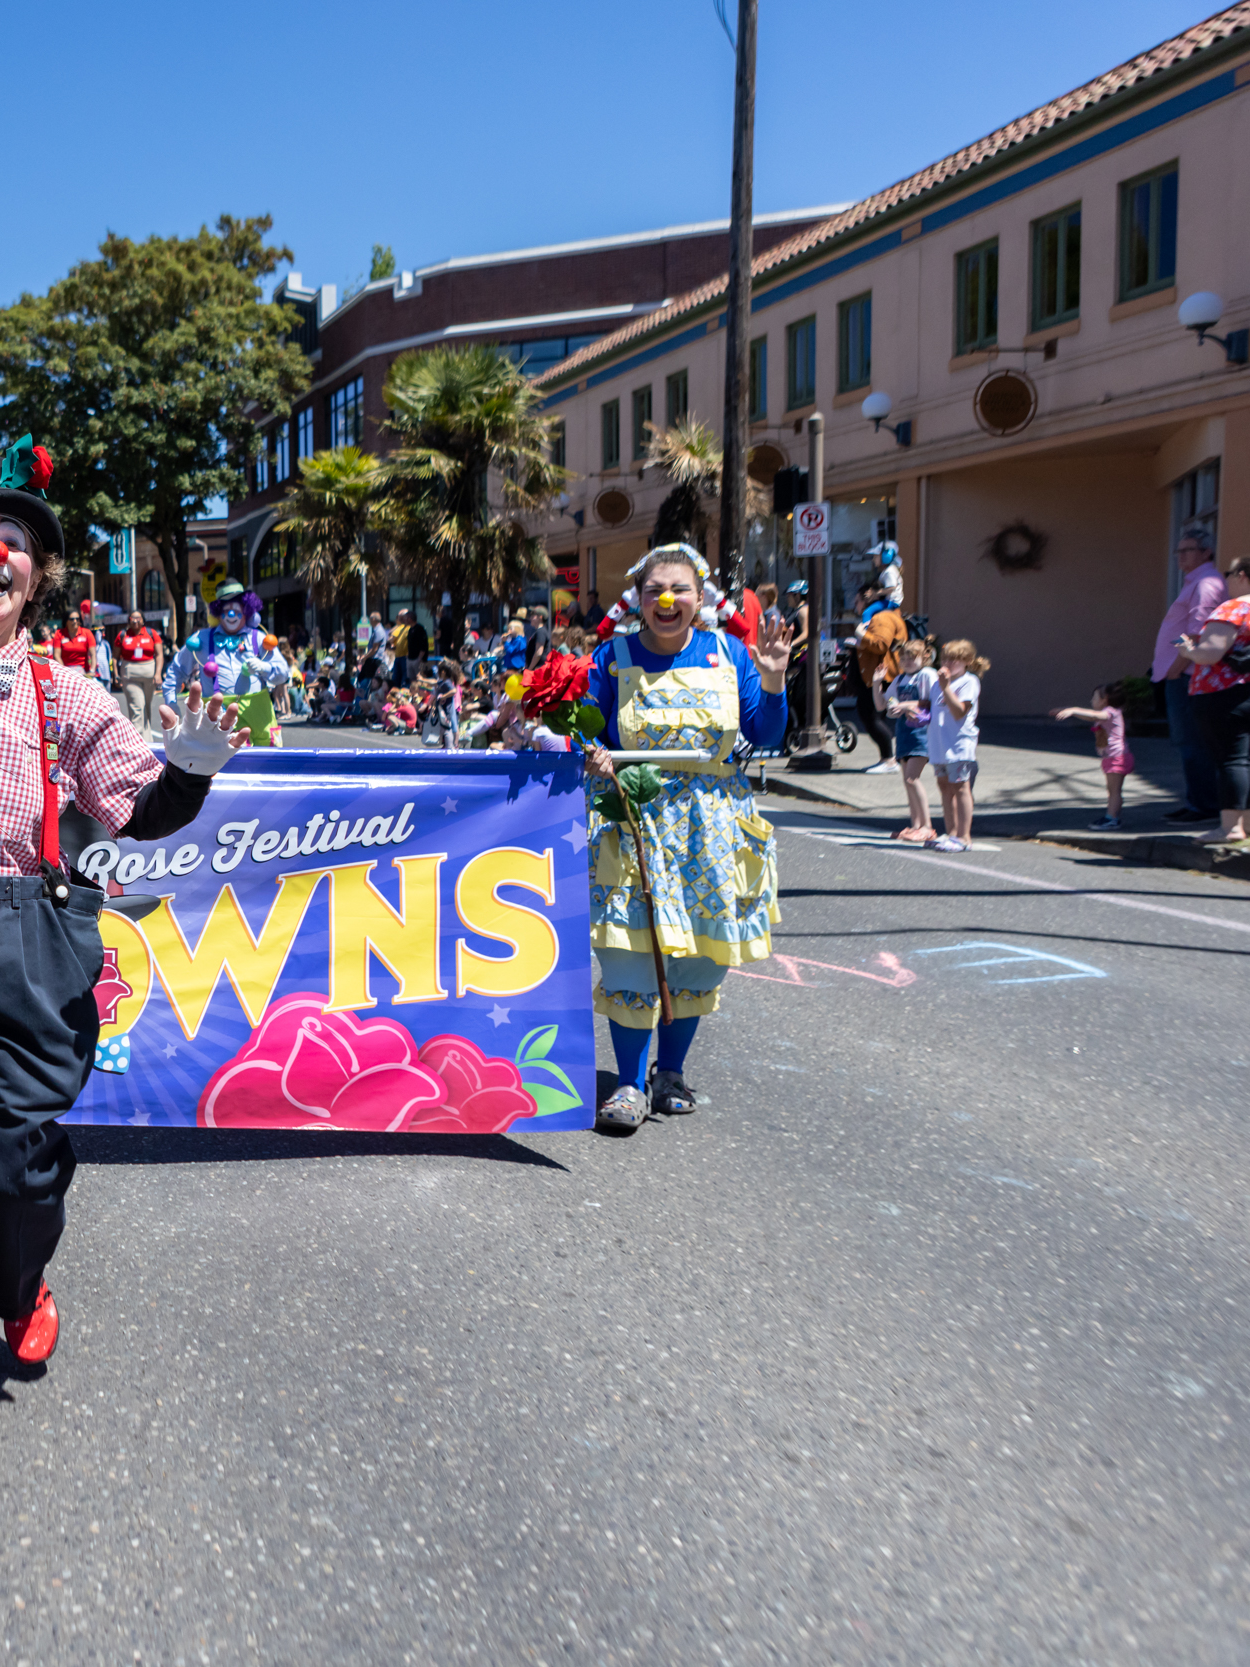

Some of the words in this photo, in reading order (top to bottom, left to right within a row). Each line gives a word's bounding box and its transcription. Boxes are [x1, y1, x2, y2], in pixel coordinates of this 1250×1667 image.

[802, 533, 822, 543] THIS
[797, 542, 827, 552] BLOCK
[77, 840, 205, 903] Rose
[211, 802, 416, 874] Festival
